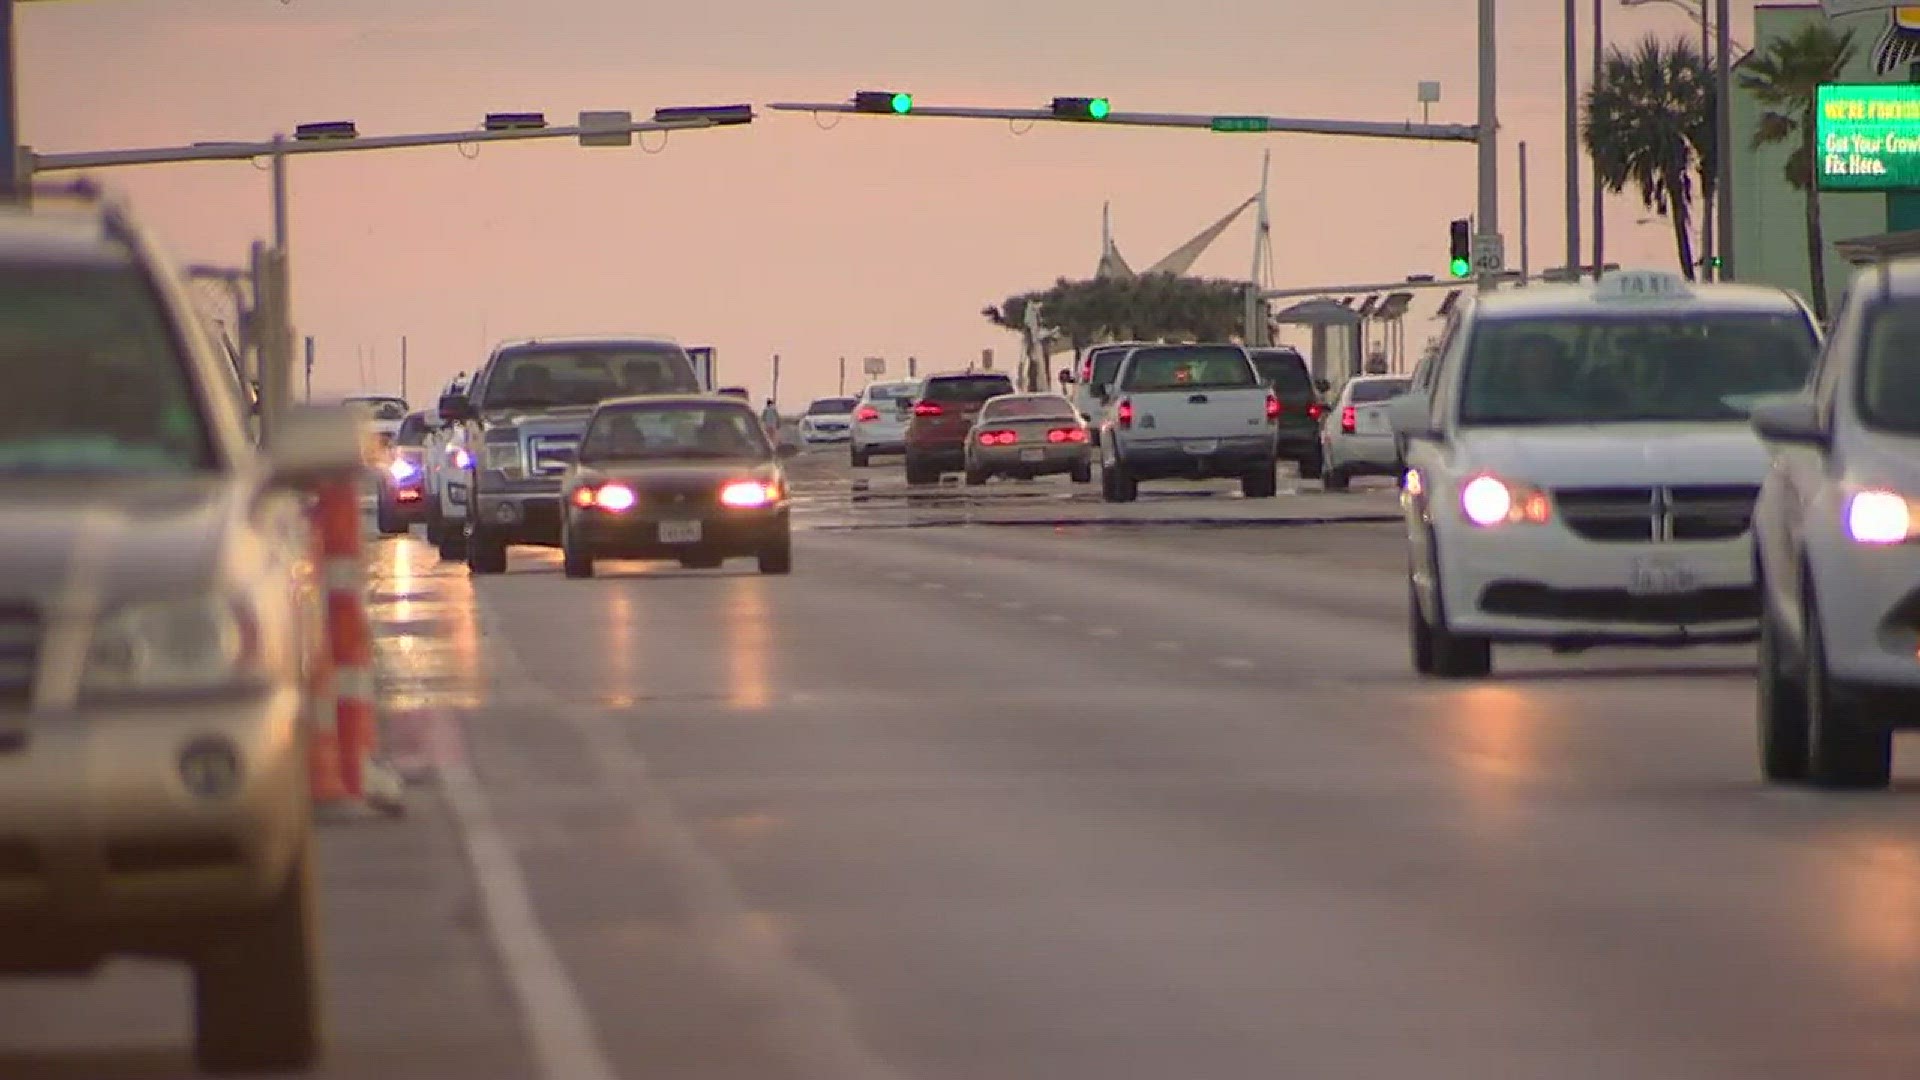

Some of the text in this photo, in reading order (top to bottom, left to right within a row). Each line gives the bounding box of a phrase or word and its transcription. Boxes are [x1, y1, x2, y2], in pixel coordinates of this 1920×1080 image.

[1851, 133, 1881, 153] Your
[1825, 154, 1847, 174] Fix
[1475, 255, 1500, 270] 40
[1620, 276, 1670, 294] TAXI
